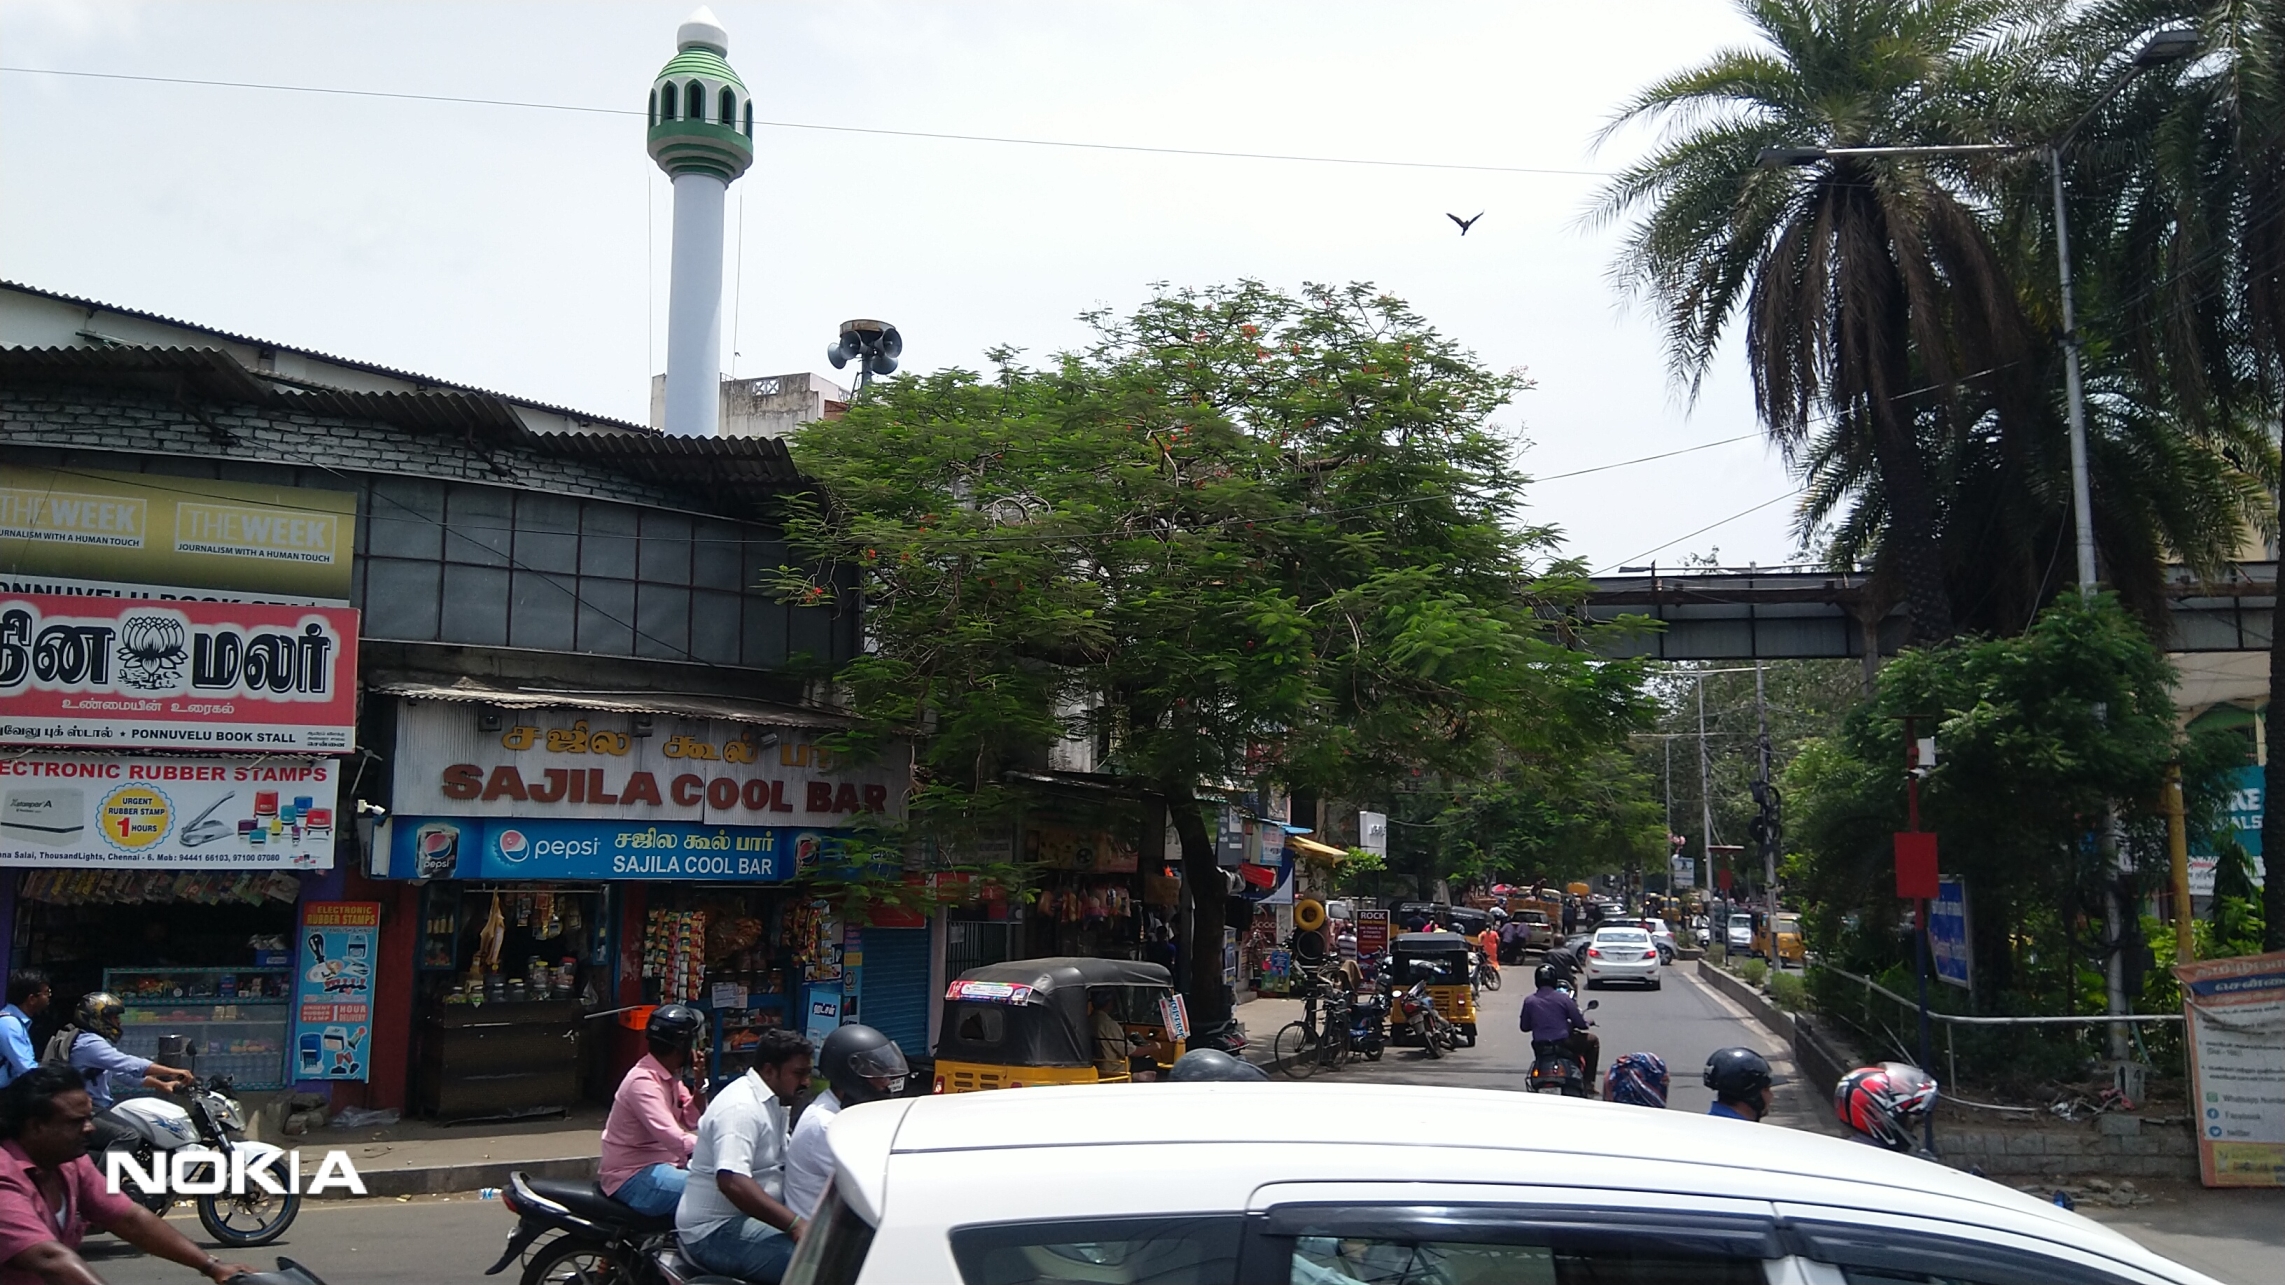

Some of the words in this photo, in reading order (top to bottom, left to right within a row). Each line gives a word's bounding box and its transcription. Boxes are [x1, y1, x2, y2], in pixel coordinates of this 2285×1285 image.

[0, 495, 46, 525] THE
[51, 500, 137, 532] WEEK
[187, 510, 239, 541] THE
[241, 515, 328, 548] WEEK
[44, 532, 66, 542] WITH
[68, 534, 74, 542] A
[75, 535, 109, 545] HUMAN
[110, 537, 140, 547] TOUCH
[178, 543, 233, 555] JOURNALISM
[235, 547, 257, 557] WITH
[266, 550, 299, 561] HUMAN
[301, 553, 330, 563] TOUCH
[192, 622, 331, 693] மலர்
[62, 697, 162, 712] உண்மையின்
[171, 702, 235, 715] உரைகல்
[44, 724, 64, 739] புக்
[67, 724, 113, 739] ஸ்டால்
[131, 729, 212, 741] PONNUVELU
[215, 731, 253, 742] BOOK
[256, 732, 296, 743] STALL
[502, 719, 632, 757] சஜில
[662, 732, 758, 765] கூல்
[780, 742, 832, 768] பா
[0, 760, 120, 779] ECTRONIC
[129, 765, 226, 781] RUBBER
[234, 767, 327, 782] STAMPS
[442, 763, 663, 806] SAJILA
[671, 773, 793, 813] COOL
[806, 780, 888, 815] BAR
[122, 797, 153, 806] URGENT
[108, 807, 139, 816] RUBBER
[140, 807, 165, 816] STAMP
[117, 817, 130, 837] 1
[131, 824, 158, 833] HOURS
[614, 826, 678, 849] சஜில
[683, 828, 731, 851] கூல்
[736, 830, 774, 852] பார்
[14, 851, 37, 861] Salai,
[108, 853, 140, 861] Chennai
[535, 837, 599, 860] pepsi
[423, 860, 450, 869] pepsi
[613, 855, 680, 873] SAJILA
[684, 856, 733, 874] COOL
[738, 857, 772, 875] BAR
[317, 906, 373, 914] ELECTRONIC
[1360, 912, 1385, 920] ROCK
[306, 914, 340, 925] RUBBER
[342, 914, 376, 925] STAMPS
[333, 1004, 338, 1021] 1
[339, 1005, 366, 1014] HOUR
